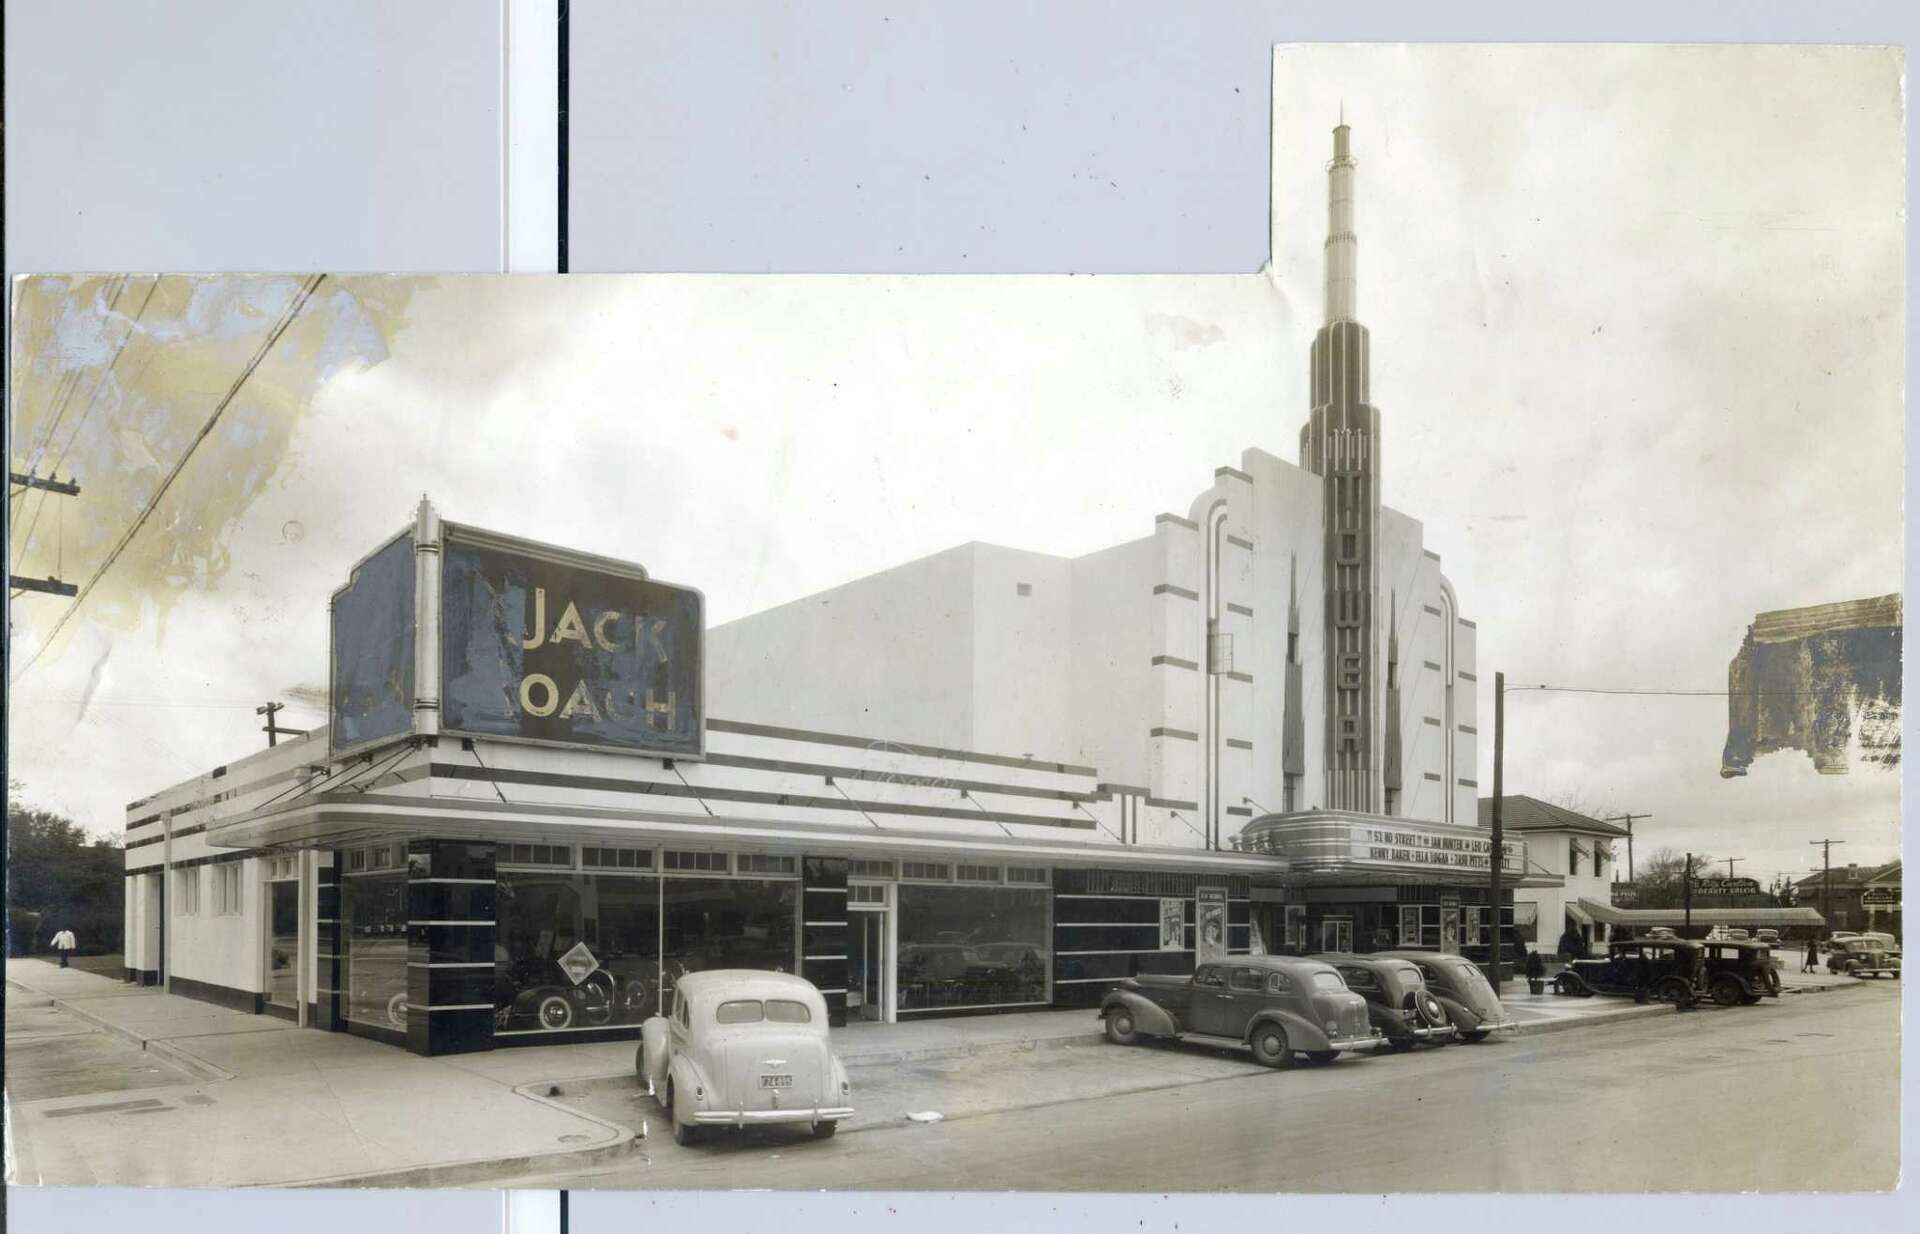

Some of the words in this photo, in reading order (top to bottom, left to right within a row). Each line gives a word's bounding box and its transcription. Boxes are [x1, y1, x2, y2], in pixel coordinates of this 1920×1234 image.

[520, 587, 668, 663] JACK
[1336, 470, 1362, 752] TOWER
[503, 673, 677, 731] OACH
